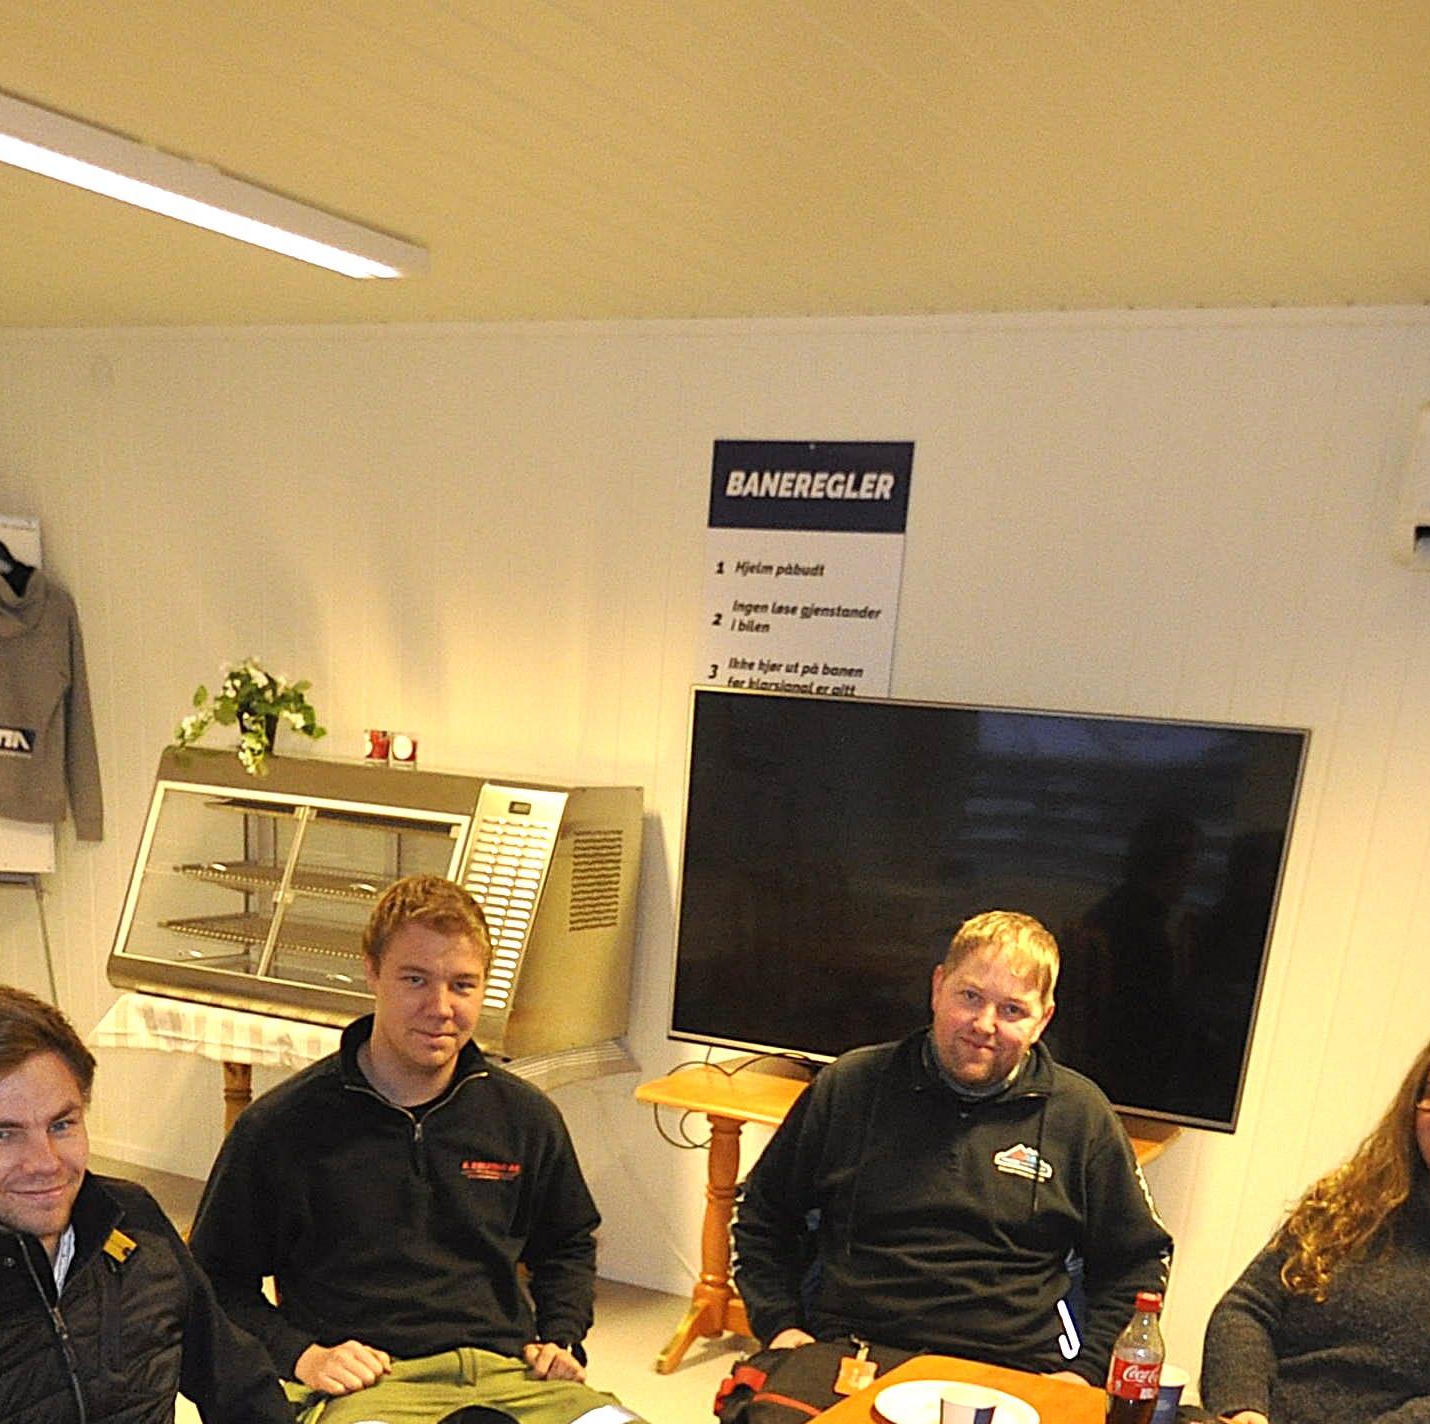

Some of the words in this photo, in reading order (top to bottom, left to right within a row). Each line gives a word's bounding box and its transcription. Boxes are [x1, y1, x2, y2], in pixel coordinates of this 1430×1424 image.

[725, 470, 895, 500] BANEREGLER
[716, 562, 725, 575] 1
[735, 561, 773, 576] Hjelm
[775, 563, 825, 577] påbudt
[732, 600, 769, 616] Ingen
[800, 604, 882, 619] gjenstander
[712, 613, 723, 626] 2
[738, 619, 770, 633] bilen
[708, 664, 719, 679] 3
[728, 658, 755, 671] Ikke
[785, 662, 799, 674] ut
[800, 663, 818, 677] på
[821, 664, 864, 678] banen
[816, 686, 830, 696] er
